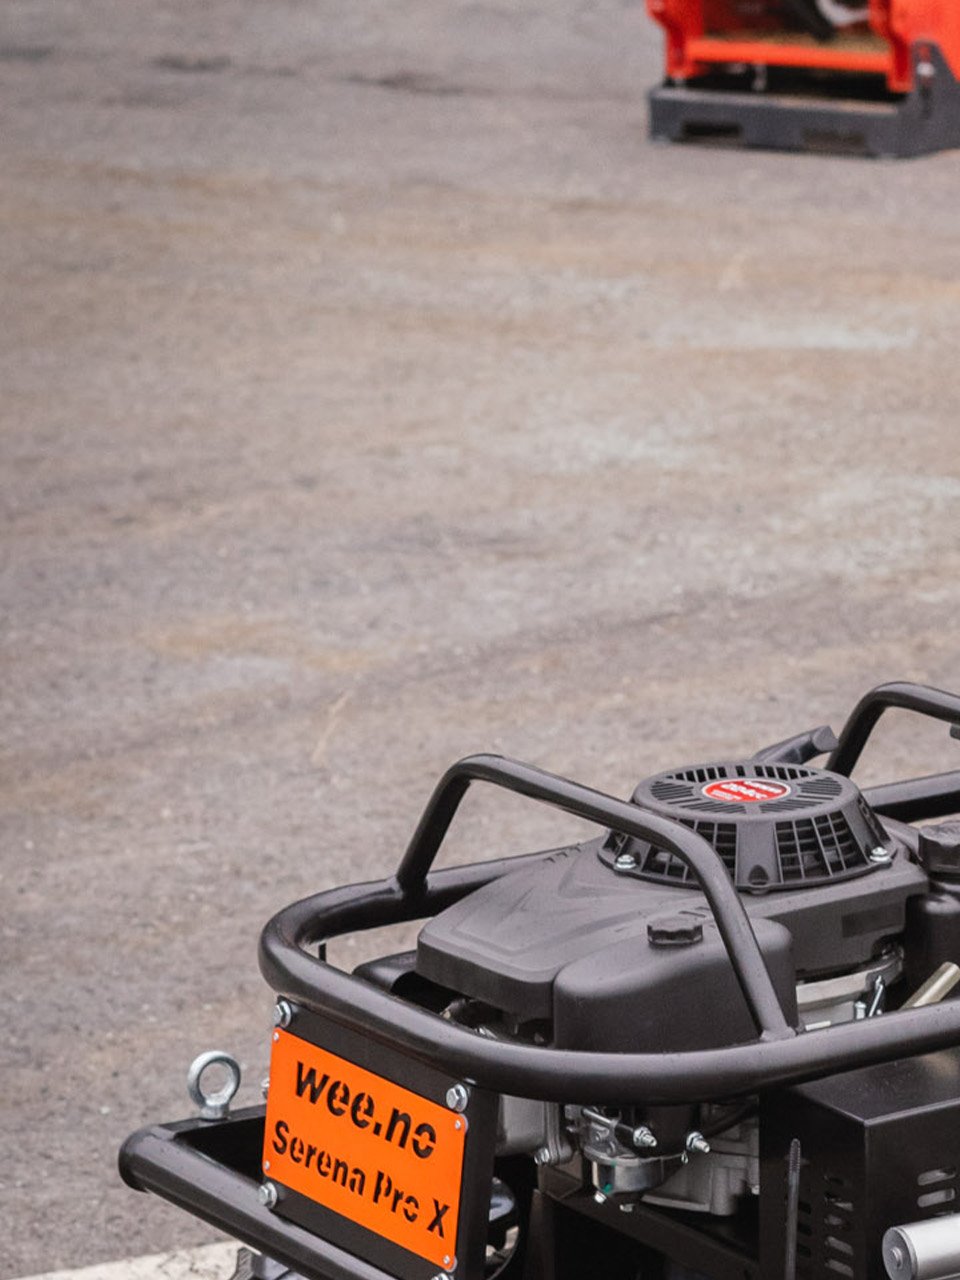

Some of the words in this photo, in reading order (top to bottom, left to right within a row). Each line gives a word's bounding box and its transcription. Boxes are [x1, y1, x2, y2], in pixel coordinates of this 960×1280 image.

[294, 1060, 437, 1160] wee.no
[271, 1119, 366, 1197] Serena
[372, 1169, 421, 1223] Pro
[426, 1198, 451, 1239] X
